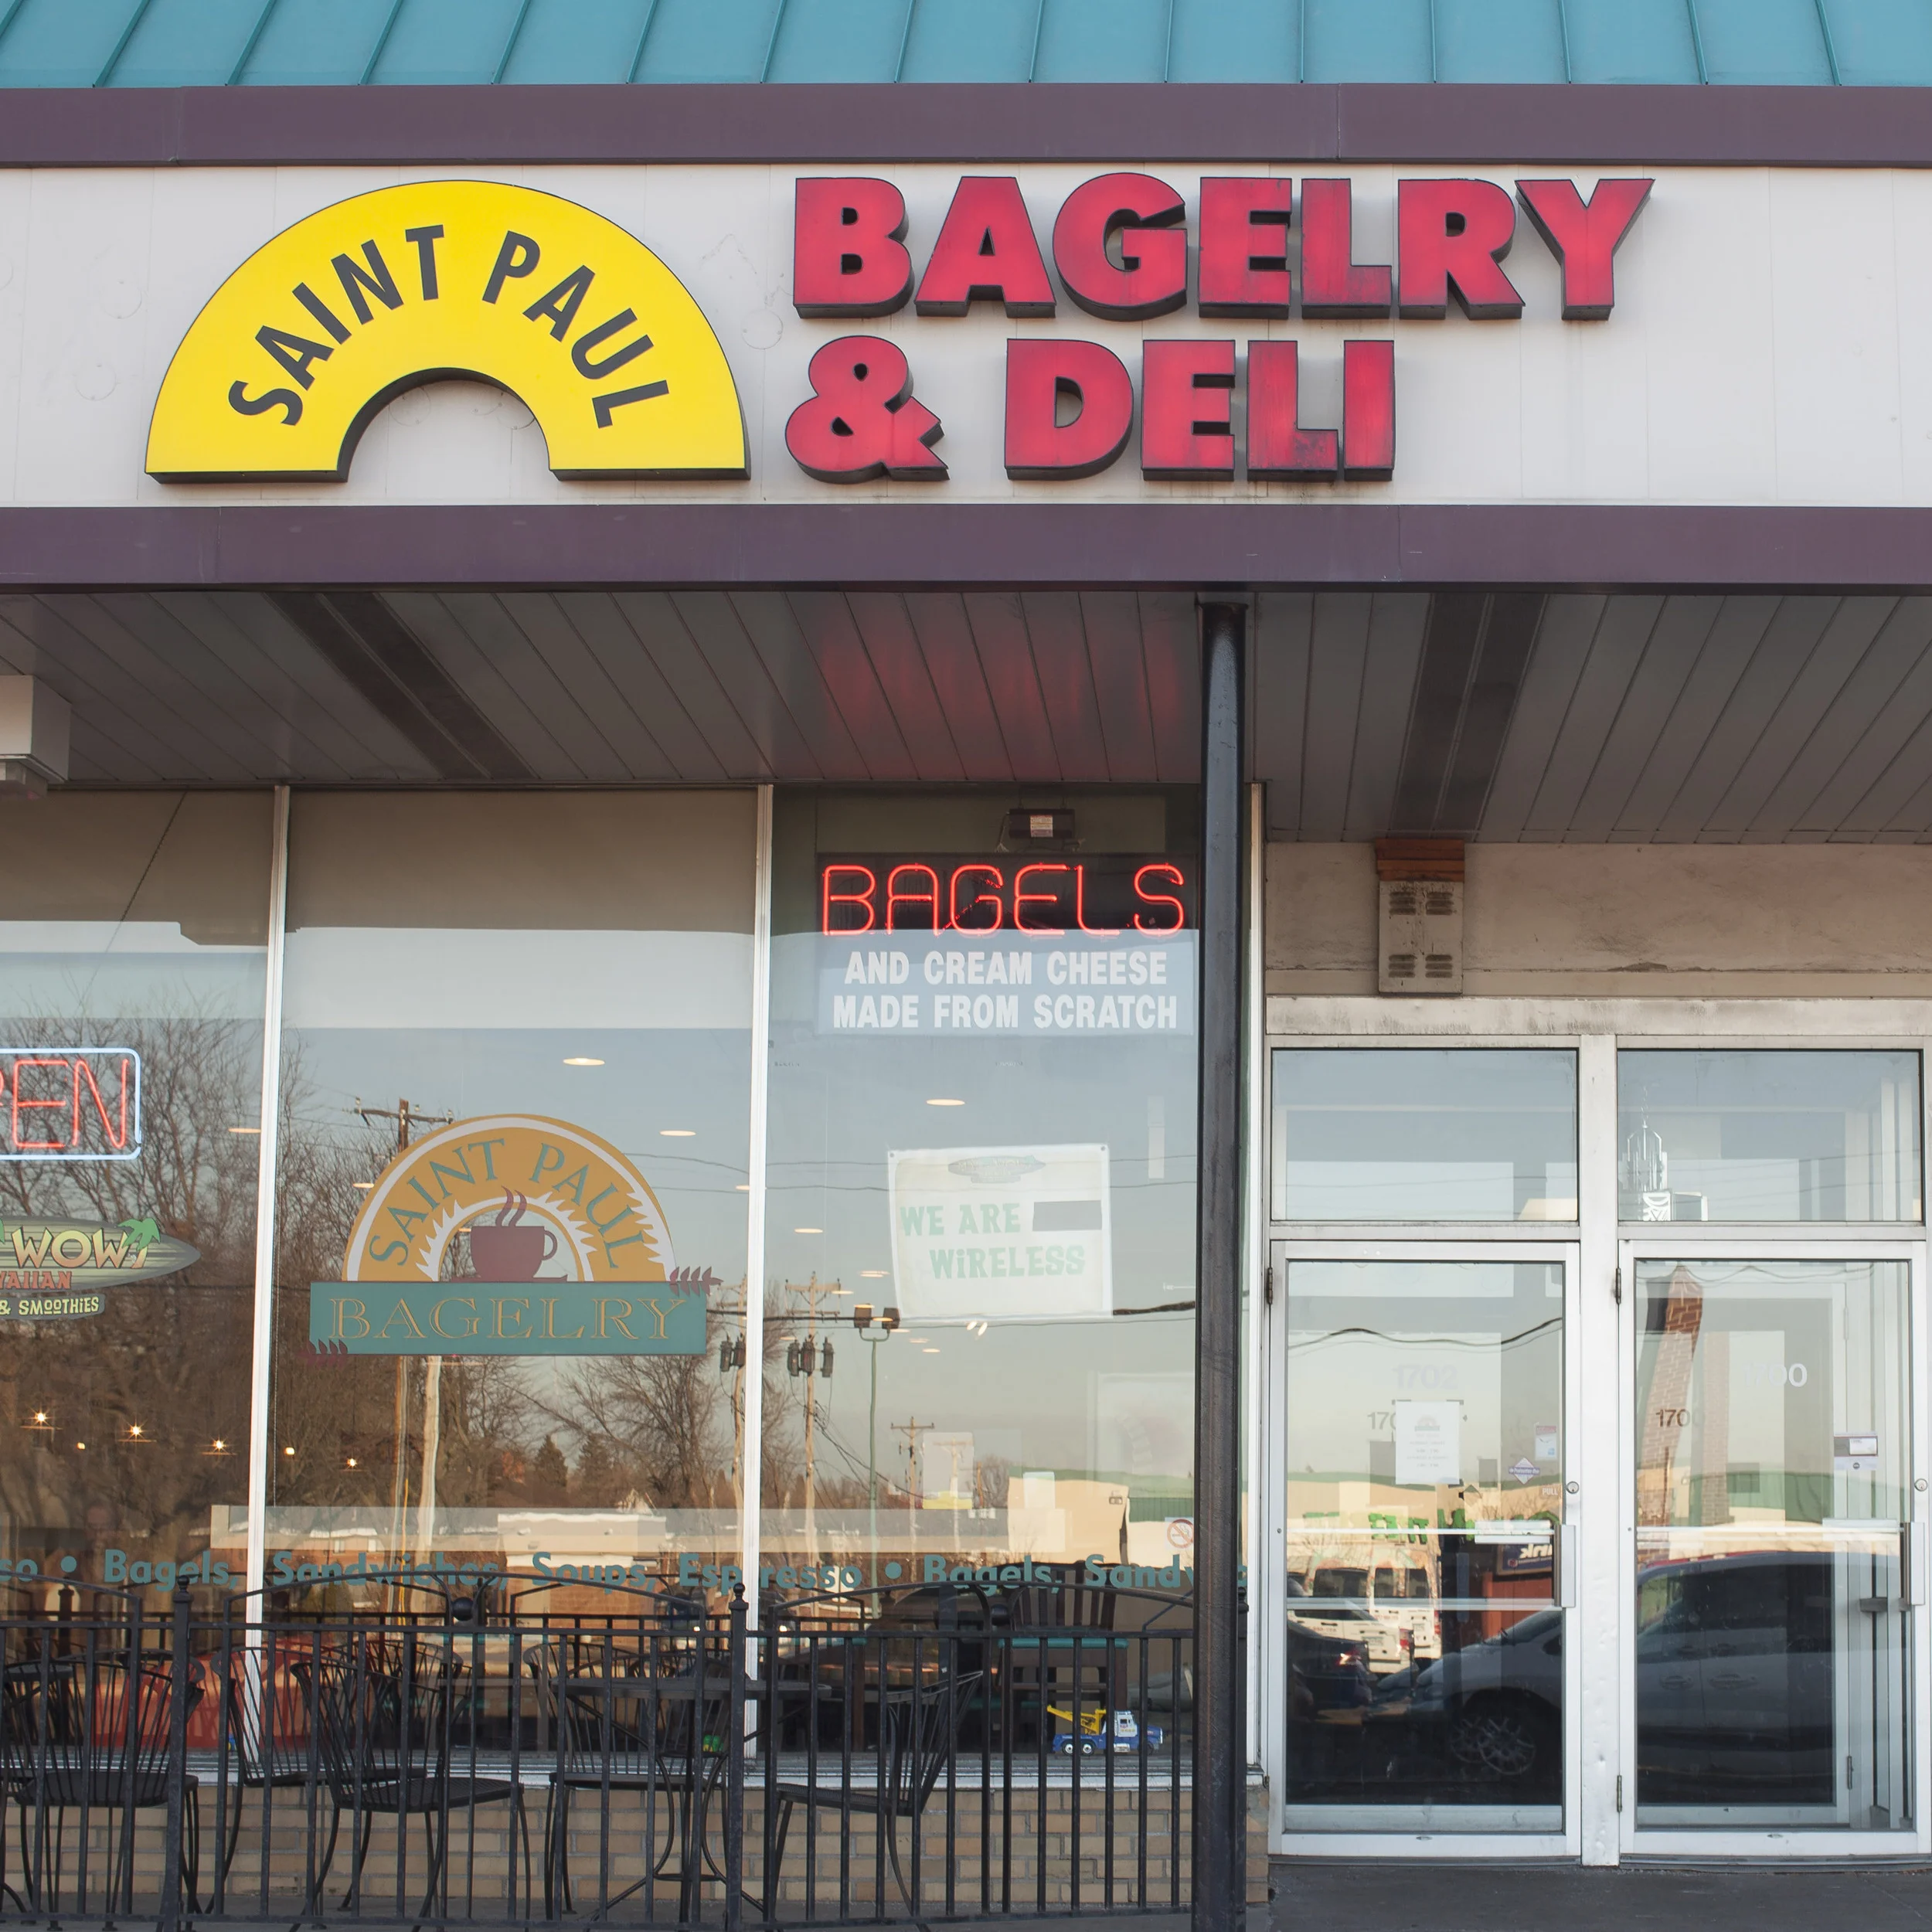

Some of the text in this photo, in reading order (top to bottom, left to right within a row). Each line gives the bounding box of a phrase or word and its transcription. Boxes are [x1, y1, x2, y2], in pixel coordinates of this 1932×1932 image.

[793, 172, 1655, 321] BAGELRY
[228, 225, 670, 429] SAINT PAUL
[785, 335, 1394, 483] & DELI
[822, 864, 1184, 937] BAGELS
[844, 951, 1168, 985] AND CREAM CHEESE
[833, 995, 1178, 1029] MADE FROM SCRATCH
[0, 1059, 129, 1148] EN
[368, 1138, 646, 1269] SAINT PAUL
[900, 1202, 1021, 1236] WE ARE
[328, 1298, 687, 1340] BAGELRY
[1391, 1363, 1459, 1390] 1702
[1741, 1362, 1808, 1388] 1700
[1542, 1488, 1559, 1496] PULL
[104, 1549, 239, 1591] Bagels,
[273, 1550, 509, 1590] Sandwiches,
[532, 1552, 656, 1595] Soups,
[679, 1553, 862, 1596] Espresso
[923, 1554, 1063, 1597] Bagels,
